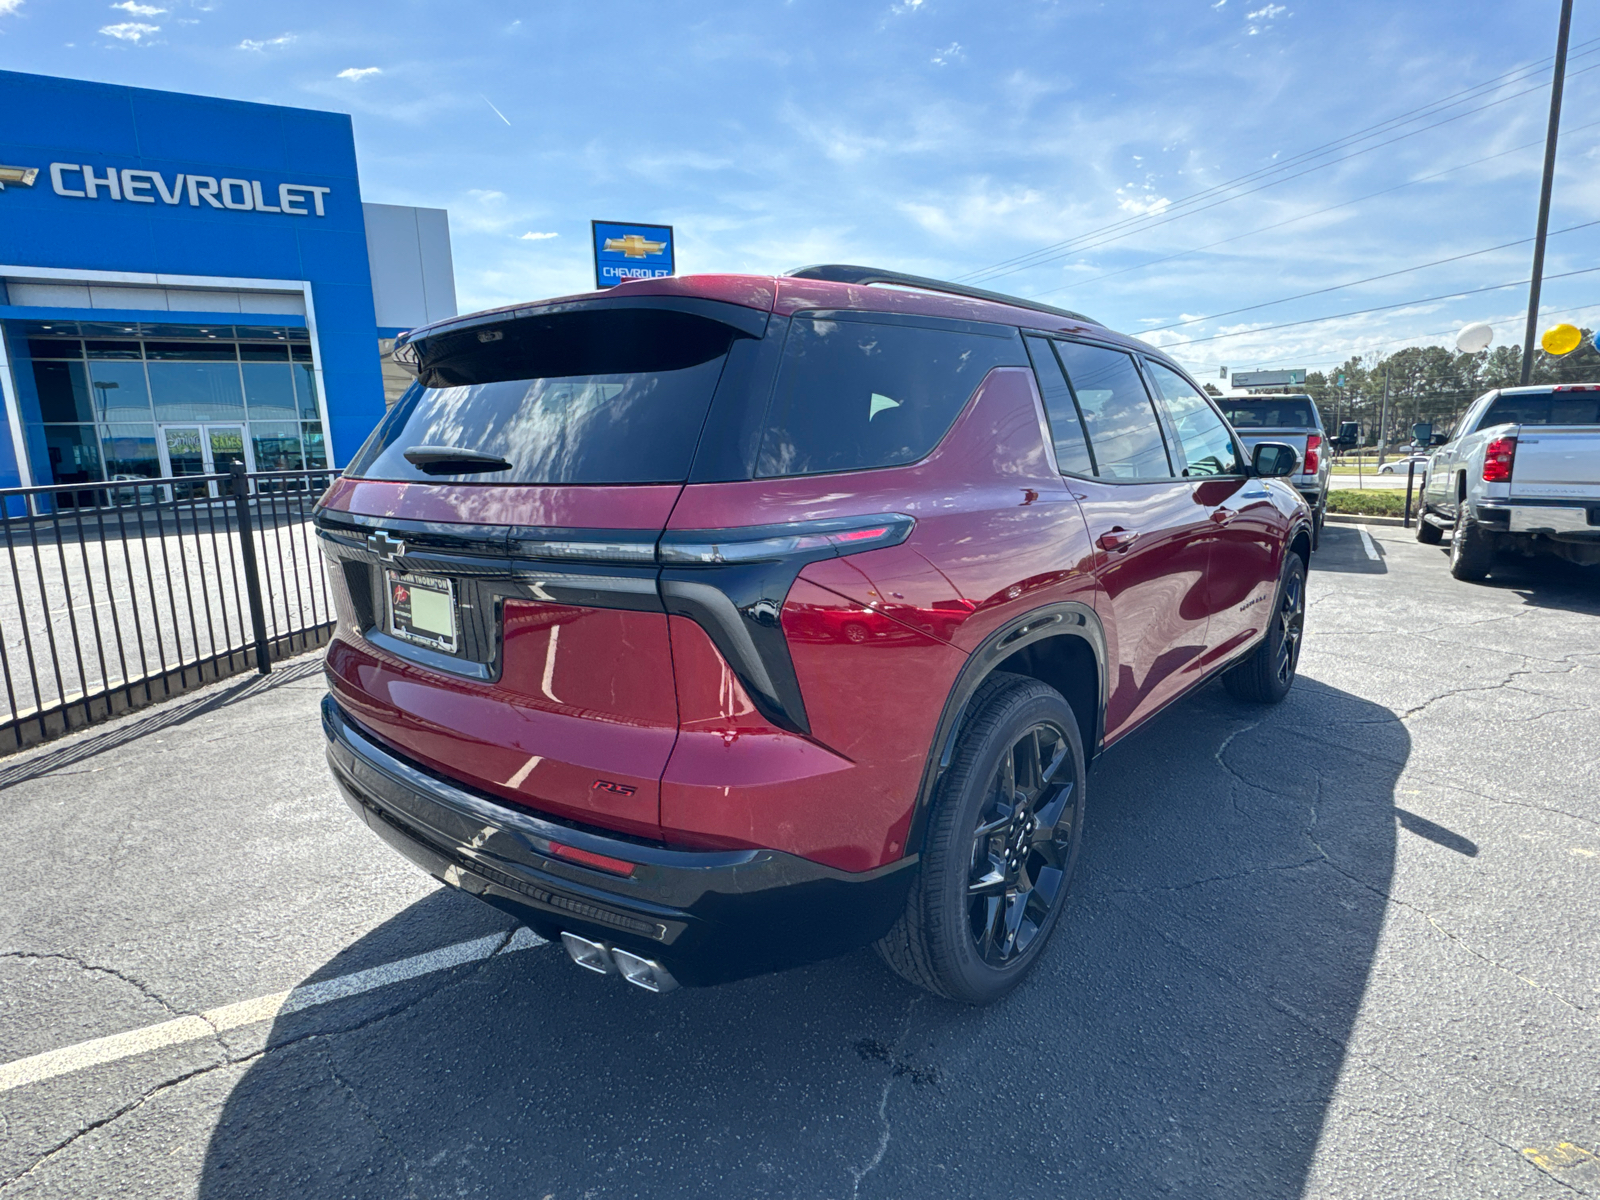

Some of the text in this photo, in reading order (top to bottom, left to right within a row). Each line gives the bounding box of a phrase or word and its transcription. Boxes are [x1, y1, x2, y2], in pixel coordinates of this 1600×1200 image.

[50, 162, 331, 217] CHEVROLET
[603, 267, 668, 278] CHEVROLET
[592, 780, 638, 797] RS
